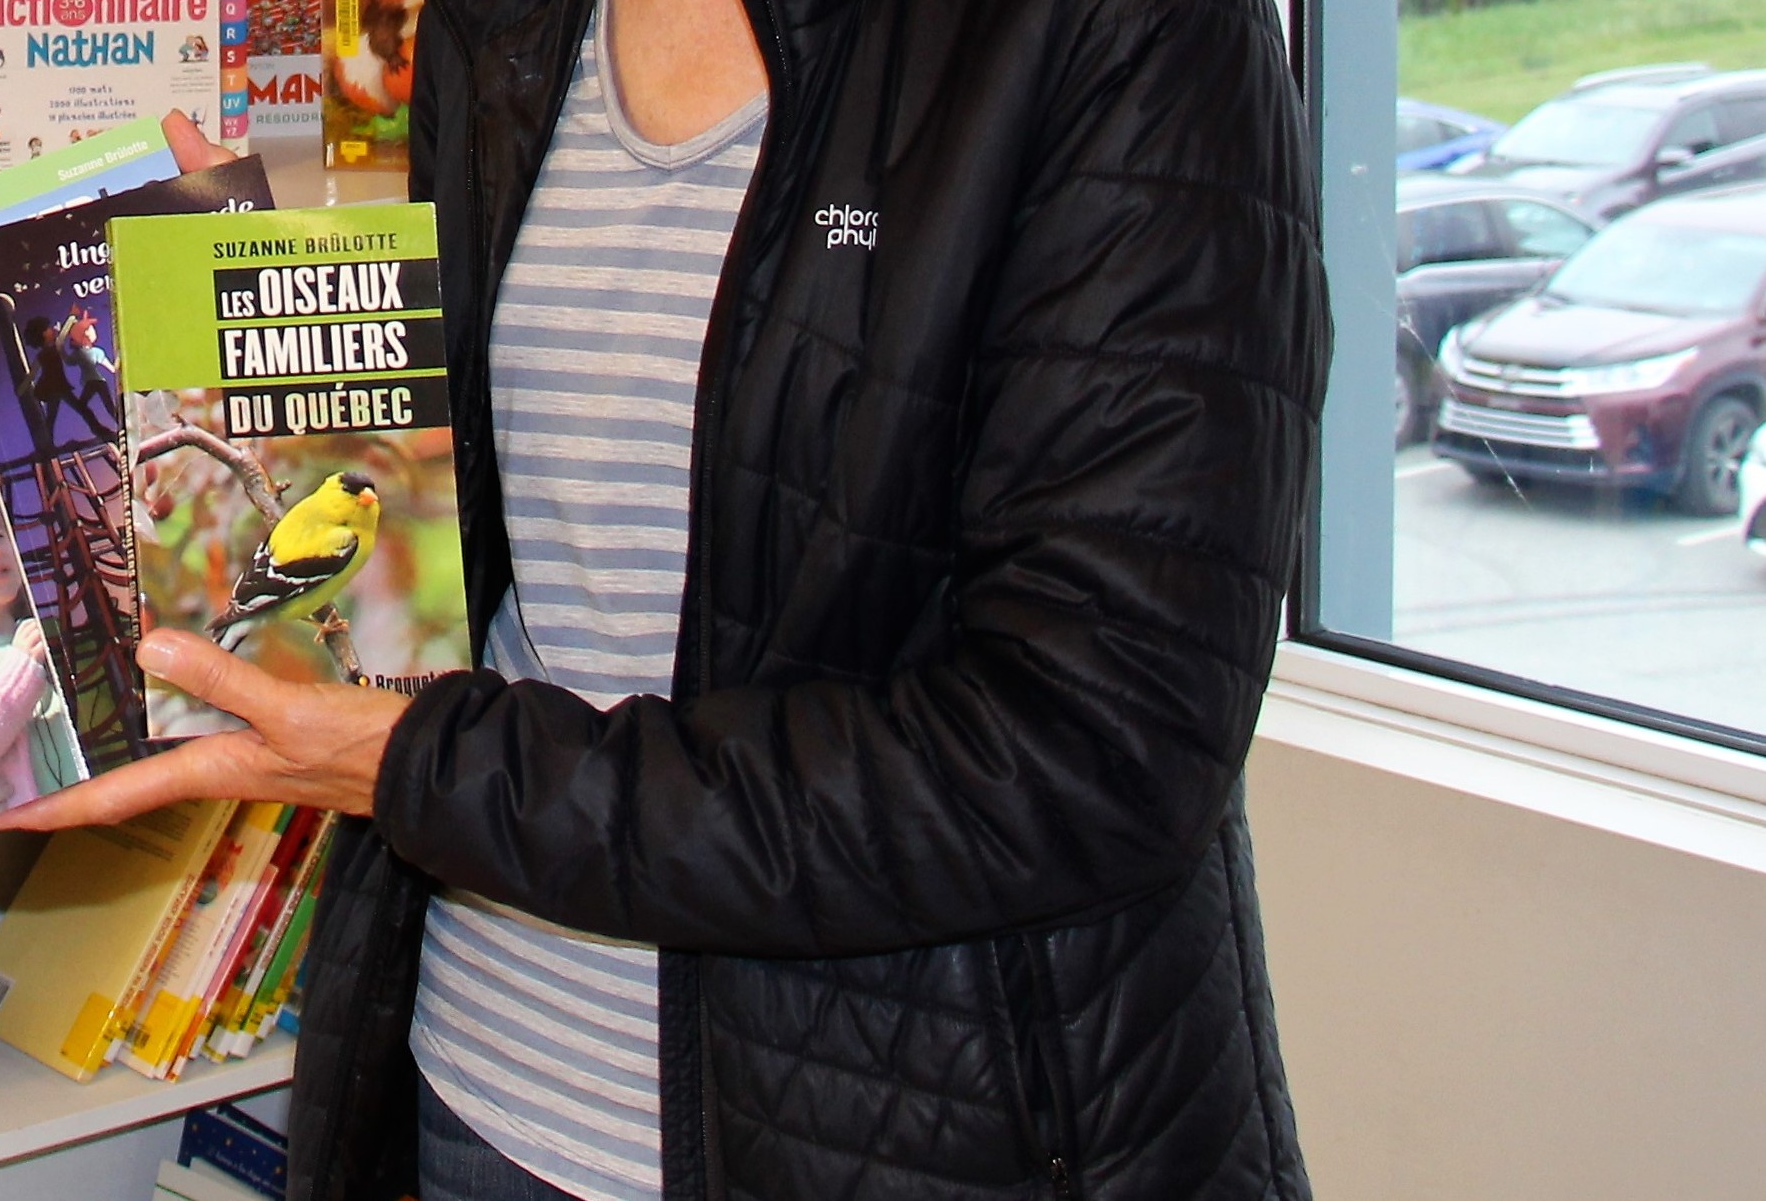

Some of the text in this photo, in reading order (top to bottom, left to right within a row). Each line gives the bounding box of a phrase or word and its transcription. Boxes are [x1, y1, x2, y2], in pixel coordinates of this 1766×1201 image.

[60, 9, 86, 21] ans
[226, 3, 236, 15] Q
[226, 28, 236, 39] R
[227, 50, 236, 63] S
[227, 74, 236, 86] T
[57, 157, 104, 181] Suzanne
[213, 232, 398, 259] SUZANNE BRÛLOTTE
[221, 261, 404, 318] LES OISEAUX
[223, 321, 409, 378] FAMILIERS
[229, 382, 414, 435] DU QUÉBEC
